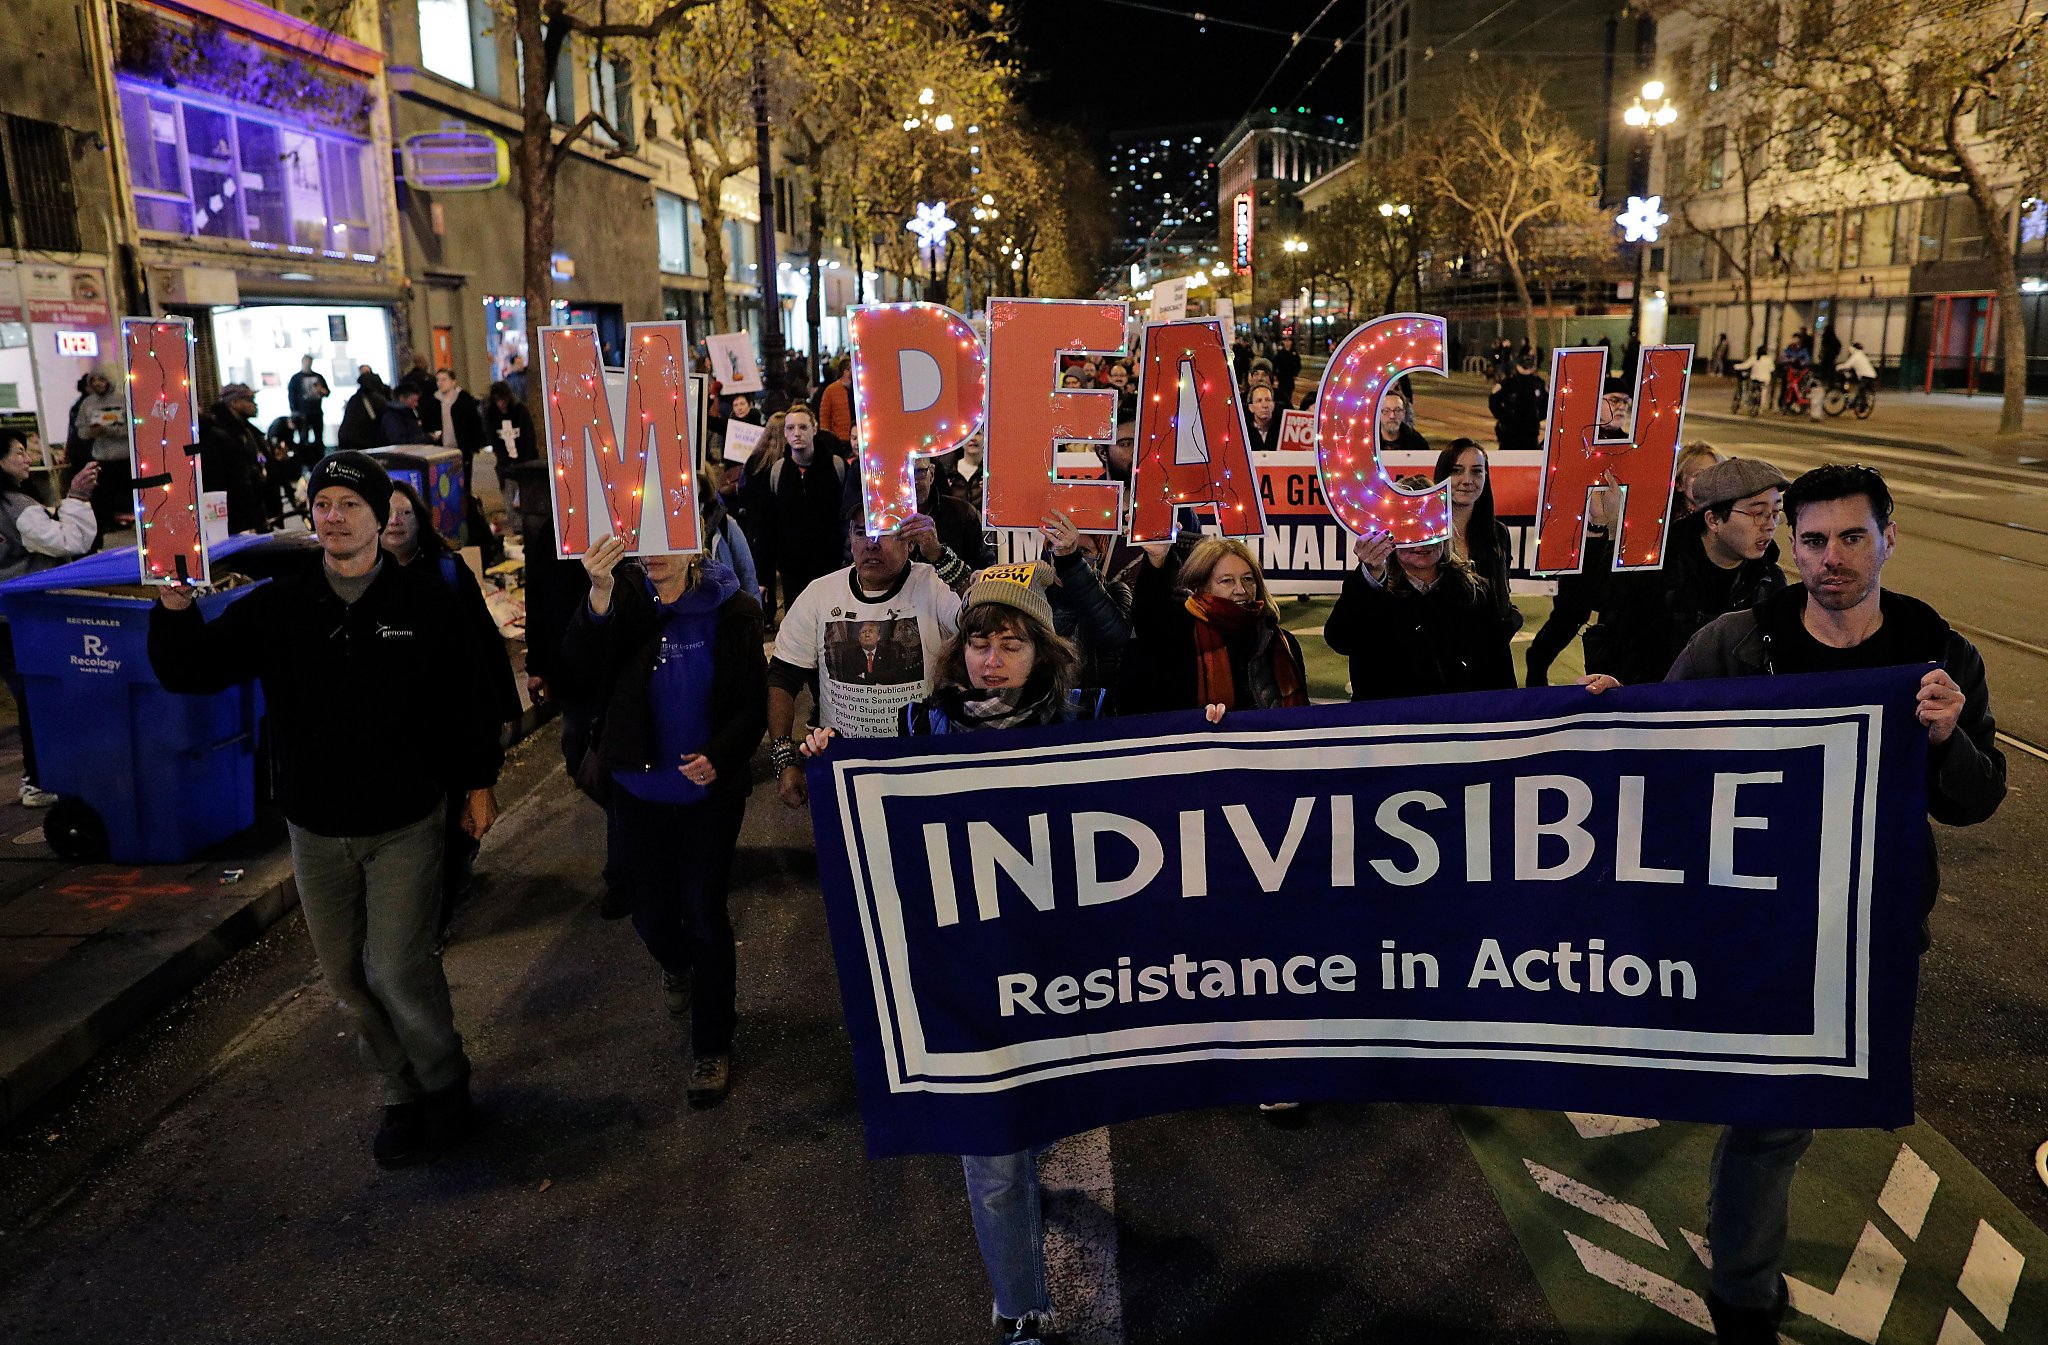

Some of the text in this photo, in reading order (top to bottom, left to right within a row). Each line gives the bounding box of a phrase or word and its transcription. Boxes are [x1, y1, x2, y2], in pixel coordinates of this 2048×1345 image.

[982, 573, 1030, 583] NOW
[66, 617, 121, 627] RECYCLABLES
[70, 655, 122, 670] Recology
[831, 681, 922, 695] The House Republicans &
[830, 689, 923, 704] Republicans Senators Are
[835, 707, 889, 724] Embarrassment
[848, 703, 858, 711] Of
[859, 705, 885, 715] Stupid
[860, 724, 870, 733] To
[922, 771, 1783, 928] INDIVISIBLE
[999, 937, 1697, 1018] Resistance in Action
